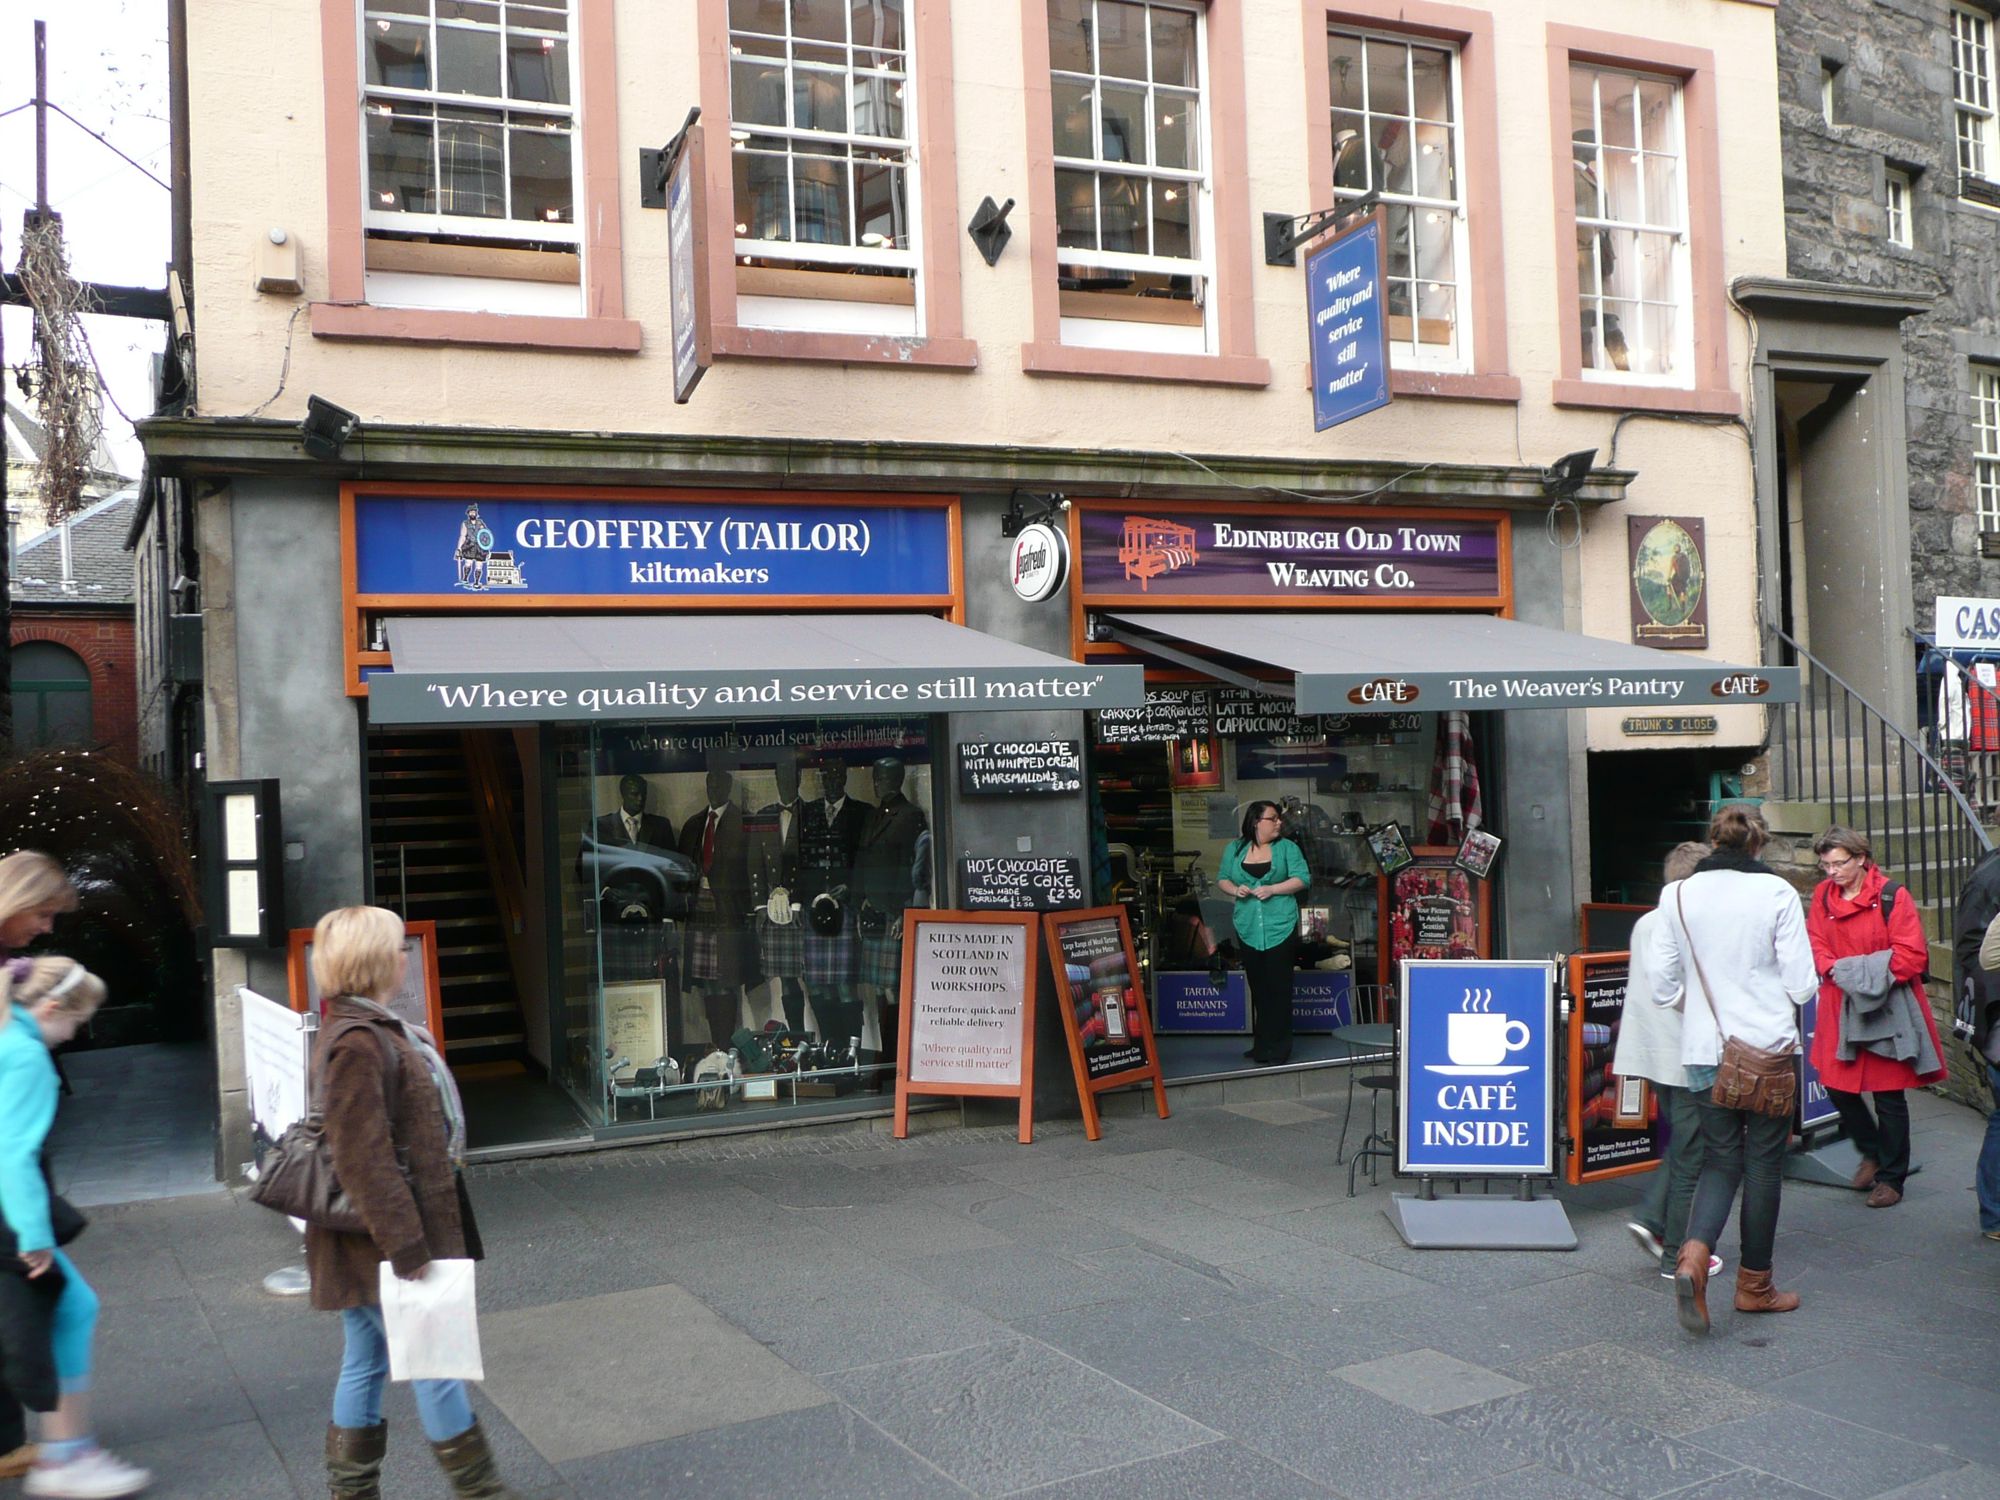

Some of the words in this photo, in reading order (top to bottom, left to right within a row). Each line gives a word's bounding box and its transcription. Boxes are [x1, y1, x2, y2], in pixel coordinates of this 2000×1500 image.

[1317, 296, 1352, 326] quality
[1352, 281, 1373, 306] and
[1328, 316, 1363, 344] service
[1337, 341, 1357, 365] still
[515, 518, 714, 550] GEOFFREY
[719, 517, 871, 557] (TAILOR)
[1213, 523, 1340, 550] EDINBURGH
[1345, 527, 1393, 551] OLD
[1398, 528, 1462, 552] TOWN
[629, 561, 770, 584] kiltmakers
[1266, 562, 1369, 588] WEAVING
[1374, 564, 1416, 588] CO.
[1361, 679, 1408, 702] CAFÉ
[1449, 679, 1498, 699] The
[1502, 677, 1603, 698] Weaver's
[1608, 676, 1684, 700] Pantry
[1721, 674, 1761, 695] CAFÉ
[426, 683, 568, 708] "Where
[578, 682, 708, 712] quality
[714, 679, 783, 704] and
[790, 679, 909, 702] service
[917, 676, 977, 699] still
[985, 674, 1104, 698] matter"
[1160, 690, 1190, 701] SOUP
[1220, 689, 1250, 699] SIT-IN
[1216, 703, 1255, 715] LATTE
[1260, 702, 1297, 715] MOCHA
[1103, 725, 1137, 736] LEEK
[1216, 717, 1287, 733] CAPPUCCINO
[1681, 719, 1713, 730] CLOSE
[755, 729, 786, 747] and
[841, 724, 863, 743] still
[962, 743, 989, 756] HOT
[997, 757, 1045, 769] WHIPPED
[967, 858, 995, 873] HOT
[982, 874, 1029, 887] FUDGE
[968, 887, 994, 895] FRESH
[929, 933, 961, 943] KILTS
[963, 934, 999, 944] MADE
[1001, 935, 1014, 944] IN
[932, 949, 994, 960] SCOTLAND
[997, 951, 1009, 960] IN
[941, 965, 967, 975] OUR
[970, 966, 999, 976] OWN
[931, 981, 1008, 992] WORKSHOPS.
[1183, 987, 1220, 996] TARTAN
[1301, 986, 1332, 995] SOCKS
[1585, 990, 1598, 999] Large
[1600, 989, 1615, 997] Range
[970, 1006, 996, 1016] quick
[998, 1006, 1016, 1015] and
[1176, 1000, 1228, 1009] REMNANTS
[930, 1018, 965, 1026] reliable
[958, 1045, 992, 1056] quality
[993, 1045, 1012, 1055] and
[921, 1059, 954, 1068] service
[956, 1059, 973, 1068] still
[1437, 1080, 1517, 1110] CAFÉ
[1422, 1121, 1529, 1147] INSIDE
